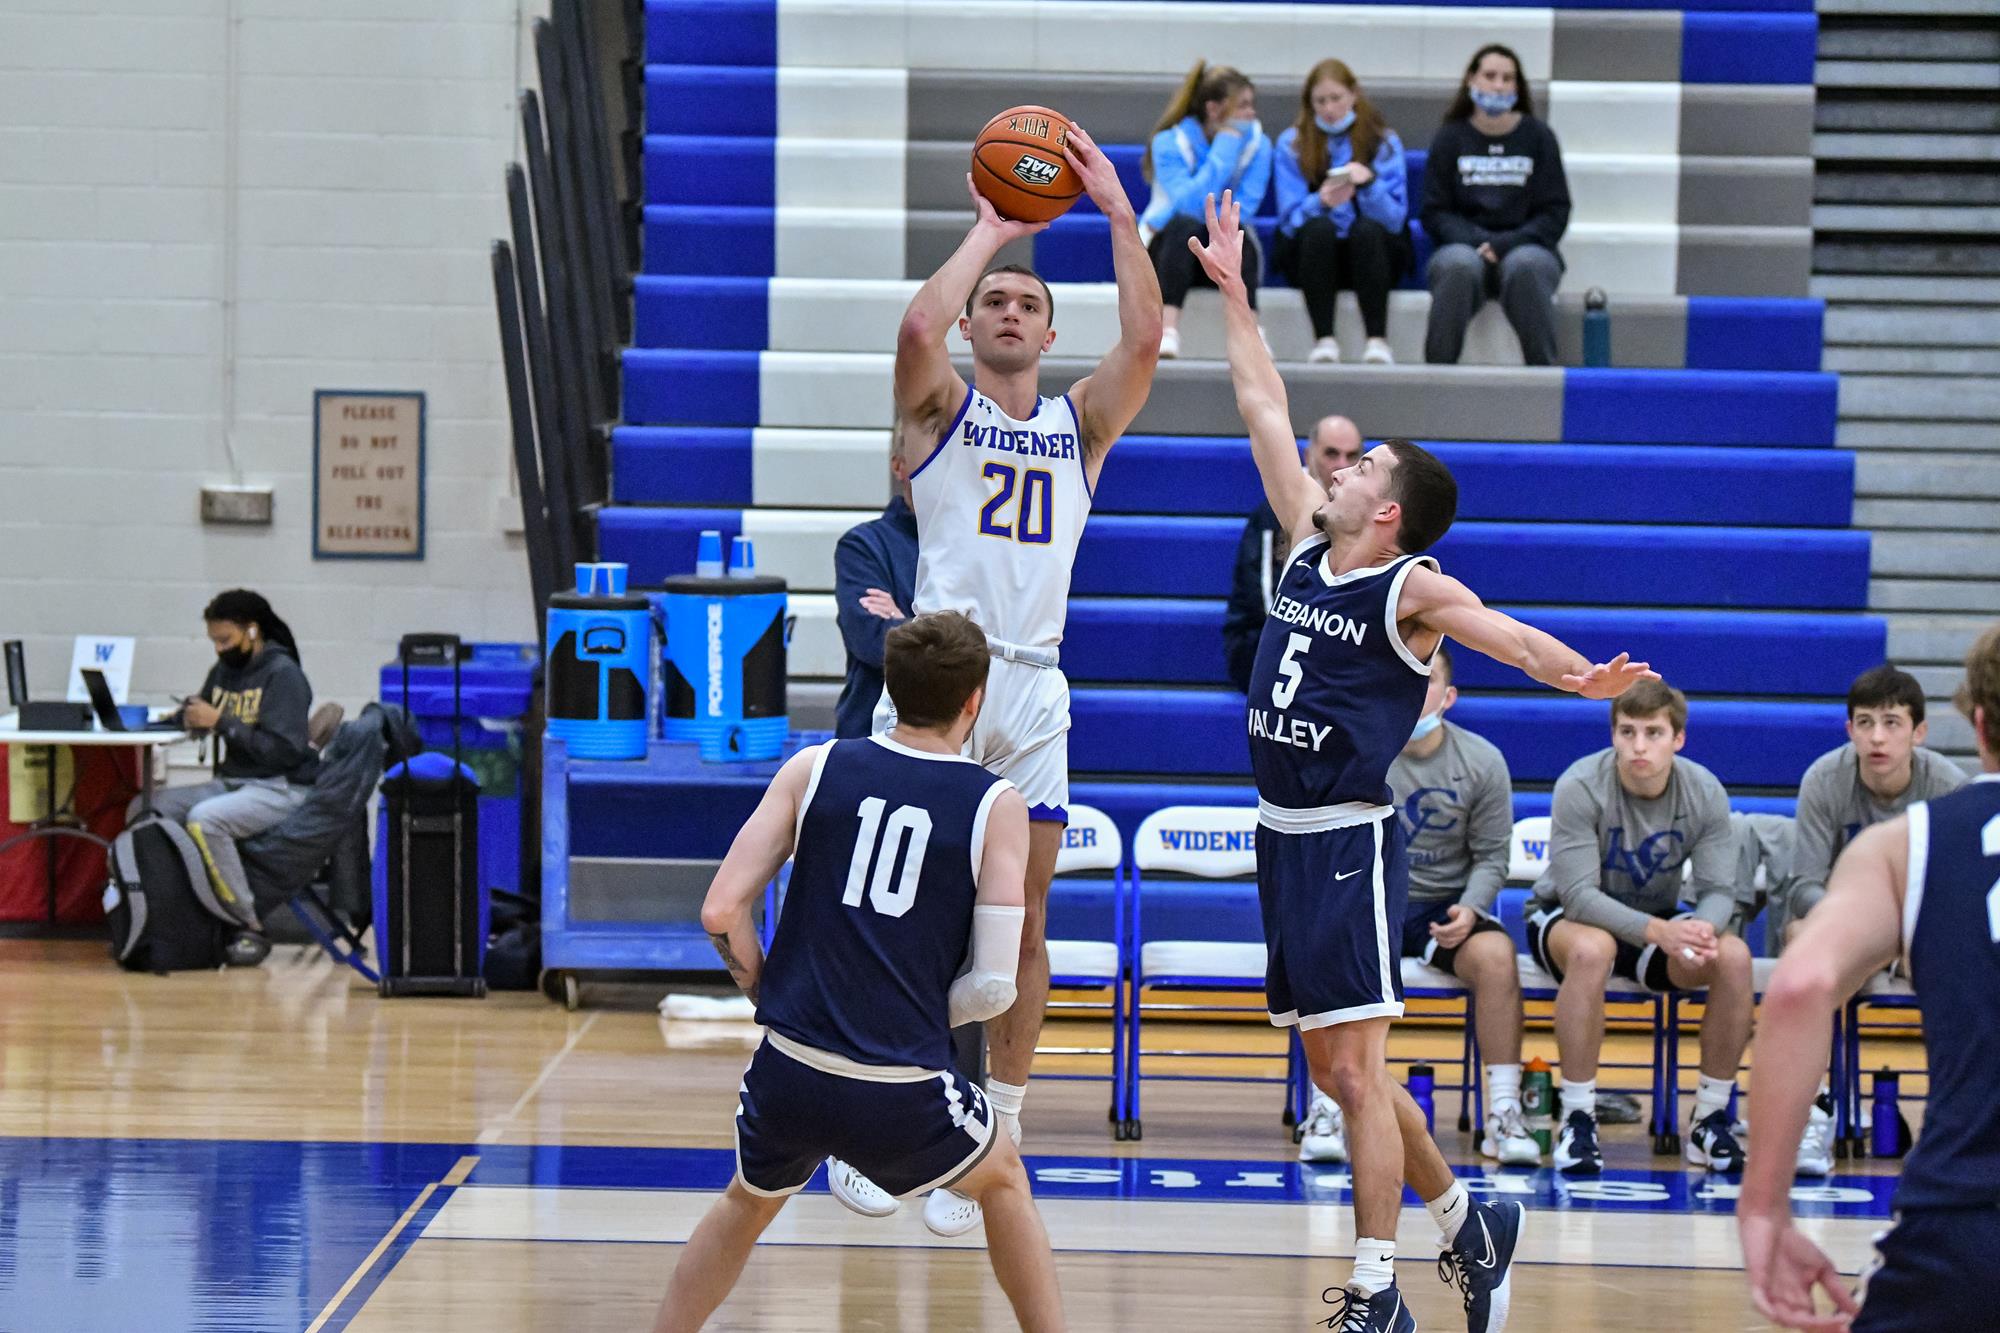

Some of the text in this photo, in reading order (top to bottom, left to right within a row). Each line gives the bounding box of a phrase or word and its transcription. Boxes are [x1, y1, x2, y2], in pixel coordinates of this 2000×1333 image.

[1008, 117, 1050, 139] ROCK
[1019, 156, 1060, 178] MAC
[342, 405, 395, 420] PLEASE
[340, 435, 397, 448] DO NOT
[963, 420, 1075, 460] WIDENER
[332, 465, 404, 480] PULL OUT
[356, 495, 382, 509] THE
[978, 460, 1054, 546] 20
[327, 525, 411, 541] BLEACHERS
[1269, 593, 1368, 646] LEBANON
[95, 644, 115, 662] W
[708, 603, 723, 716] POWERADE
[1272, 632, 1312, 709] 5
[1060, 827, 1097, 849] ER
[842, 796, 933, 918] 10
[1522, 840, 1550, 860] W
[1522, 1087, 1540, 1109] G
